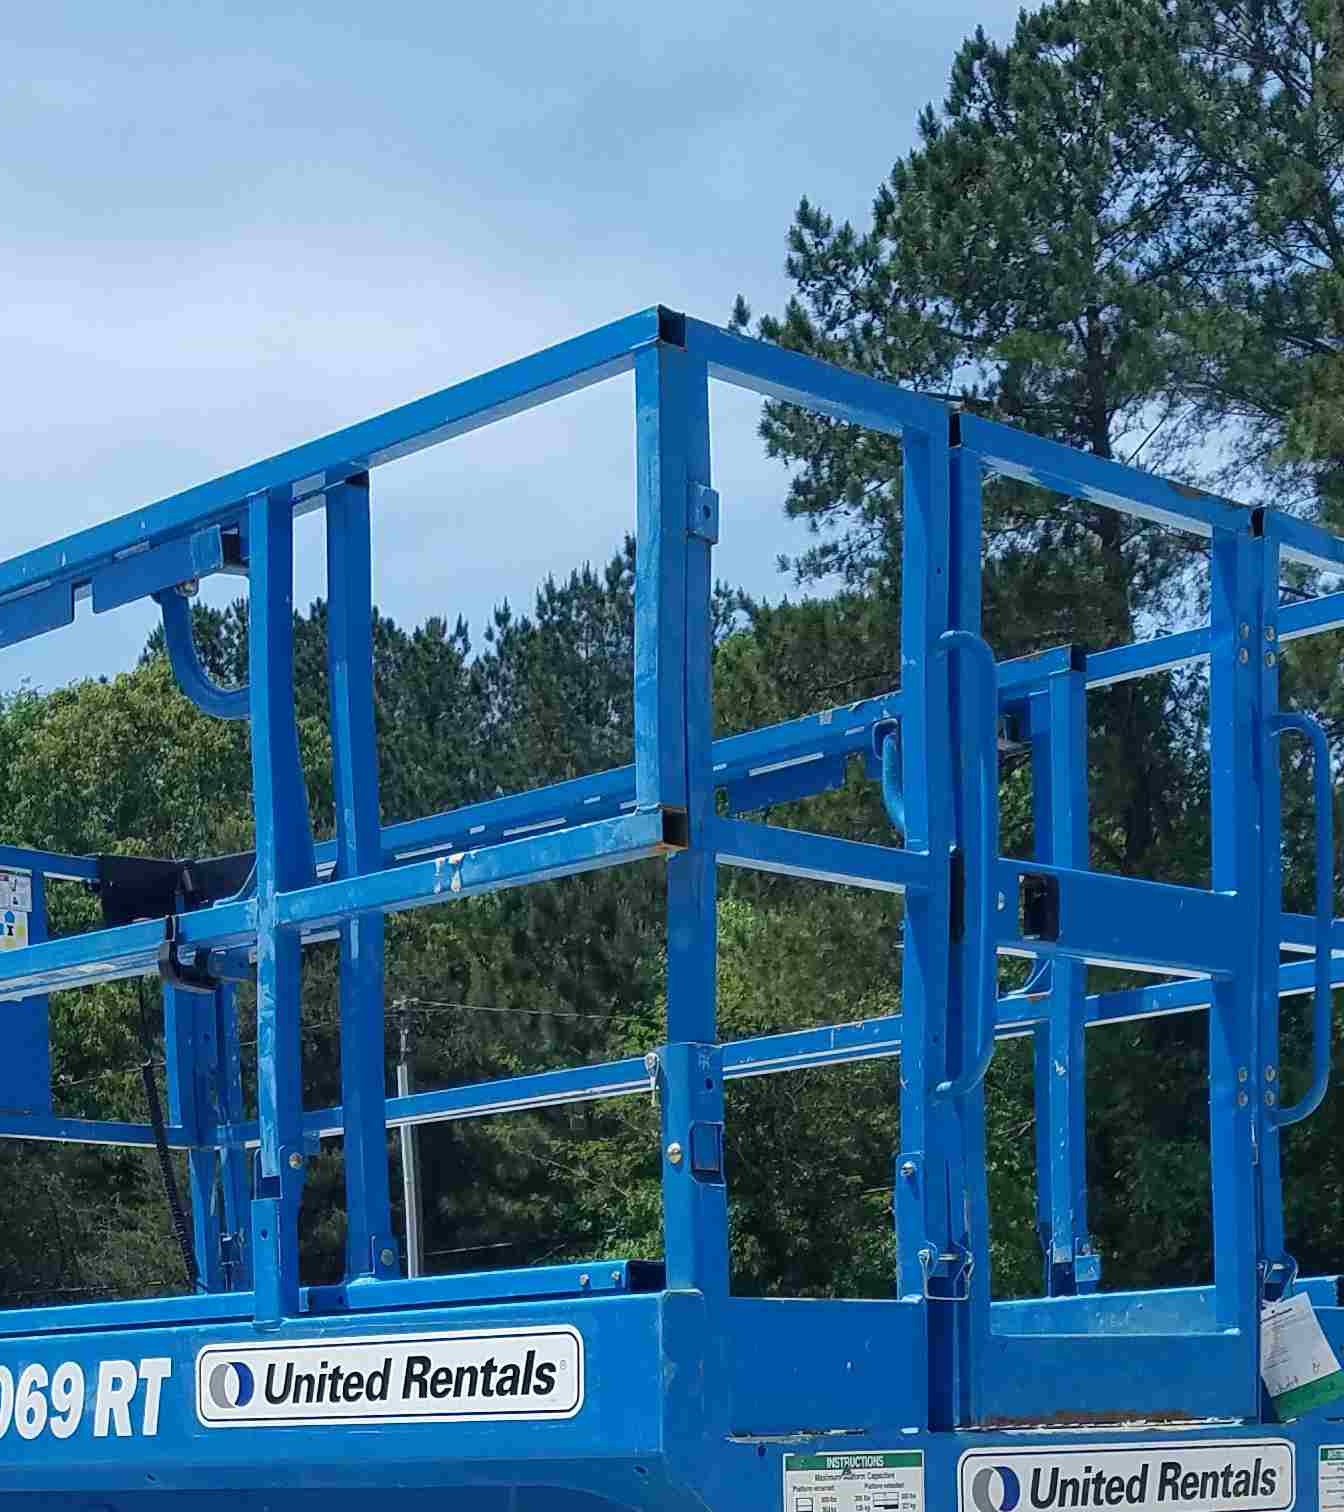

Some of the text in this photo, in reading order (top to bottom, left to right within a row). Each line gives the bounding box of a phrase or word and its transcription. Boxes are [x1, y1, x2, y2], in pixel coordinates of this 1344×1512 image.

[264, 1350, 556, 1405] United Rentals
[1030, 1461, 1147, 1508] United
[1156, 1457, 1277, 1501] Rentals
